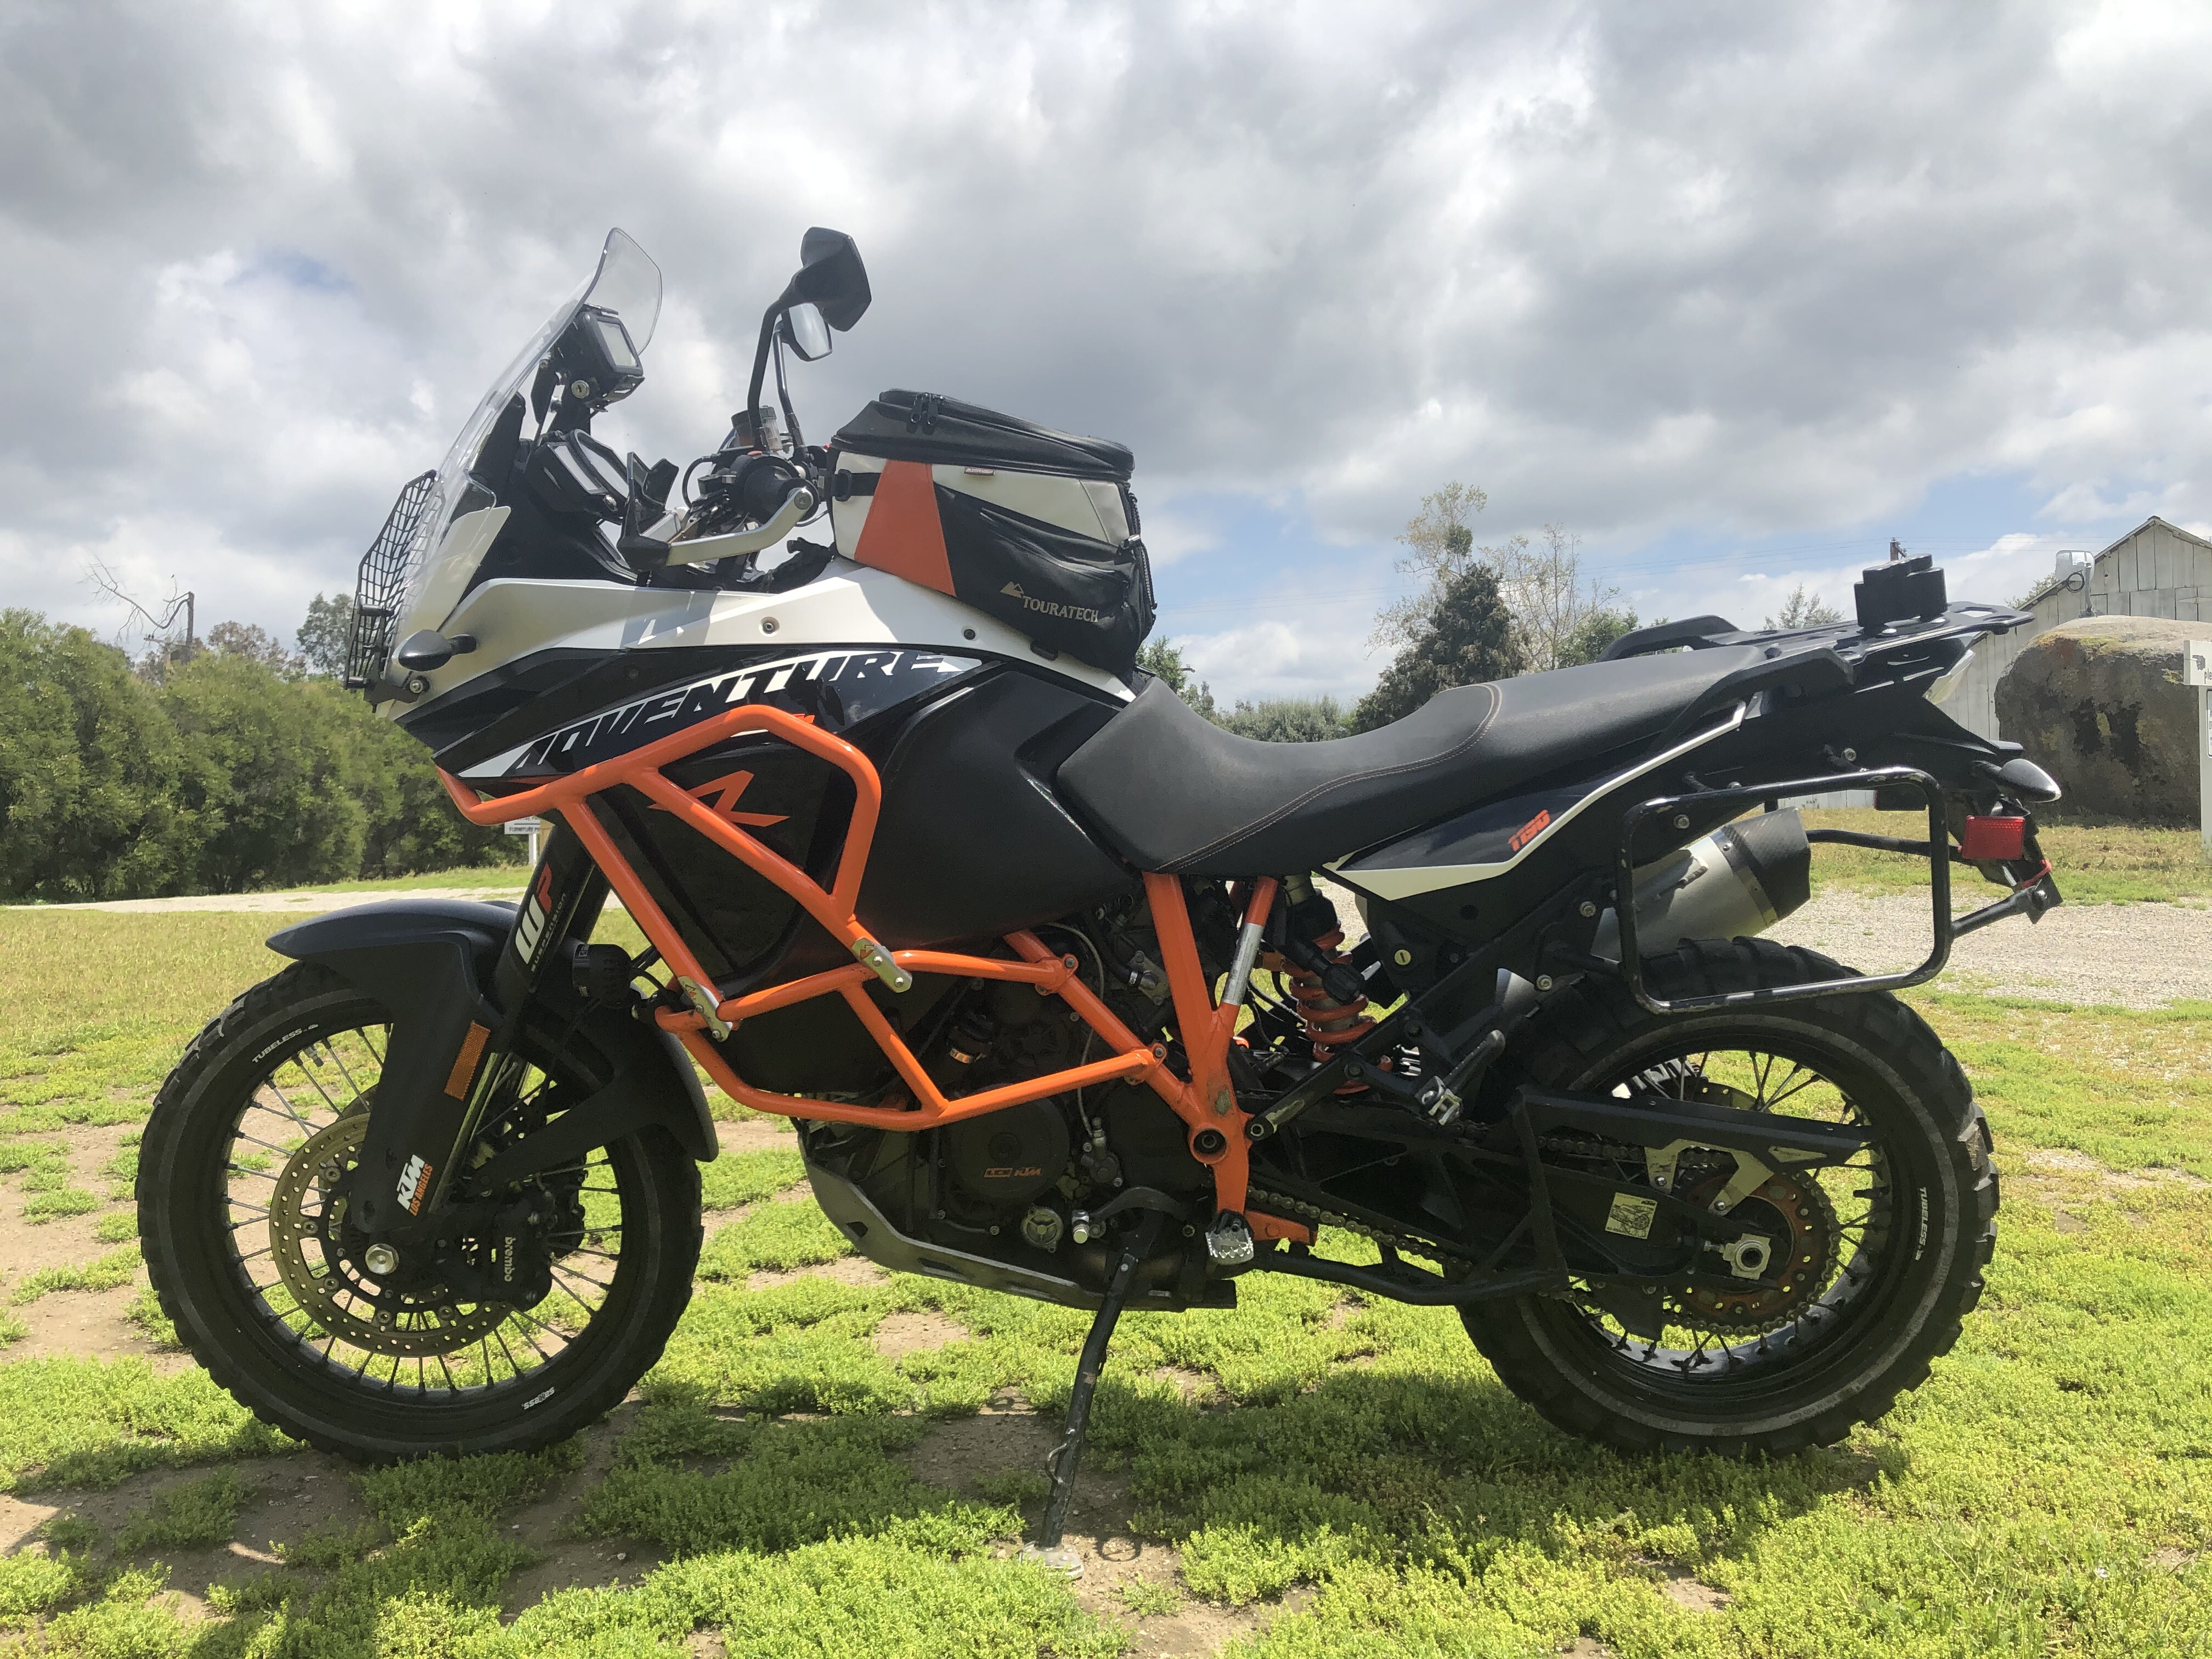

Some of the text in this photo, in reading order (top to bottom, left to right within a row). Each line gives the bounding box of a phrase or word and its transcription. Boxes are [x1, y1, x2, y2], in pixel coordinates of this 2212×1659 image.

[1023, 595, 1099, 623] TOURATECH
[504, 651, 953, 775] ADVENTURE
[1508, 809, 1551, 852] 1190
[252, 1028, 302, 1063] TUBELESS
[397, 1154, 425, 1210] KTM
[409, 1163, 433, 1216] LOS ANGELES
[1014, 1167, 1041, 1177] KTM
[1919, 1187, 1928, 1246] TUBELESS
[504, 1237, 516, 1282] brembo
